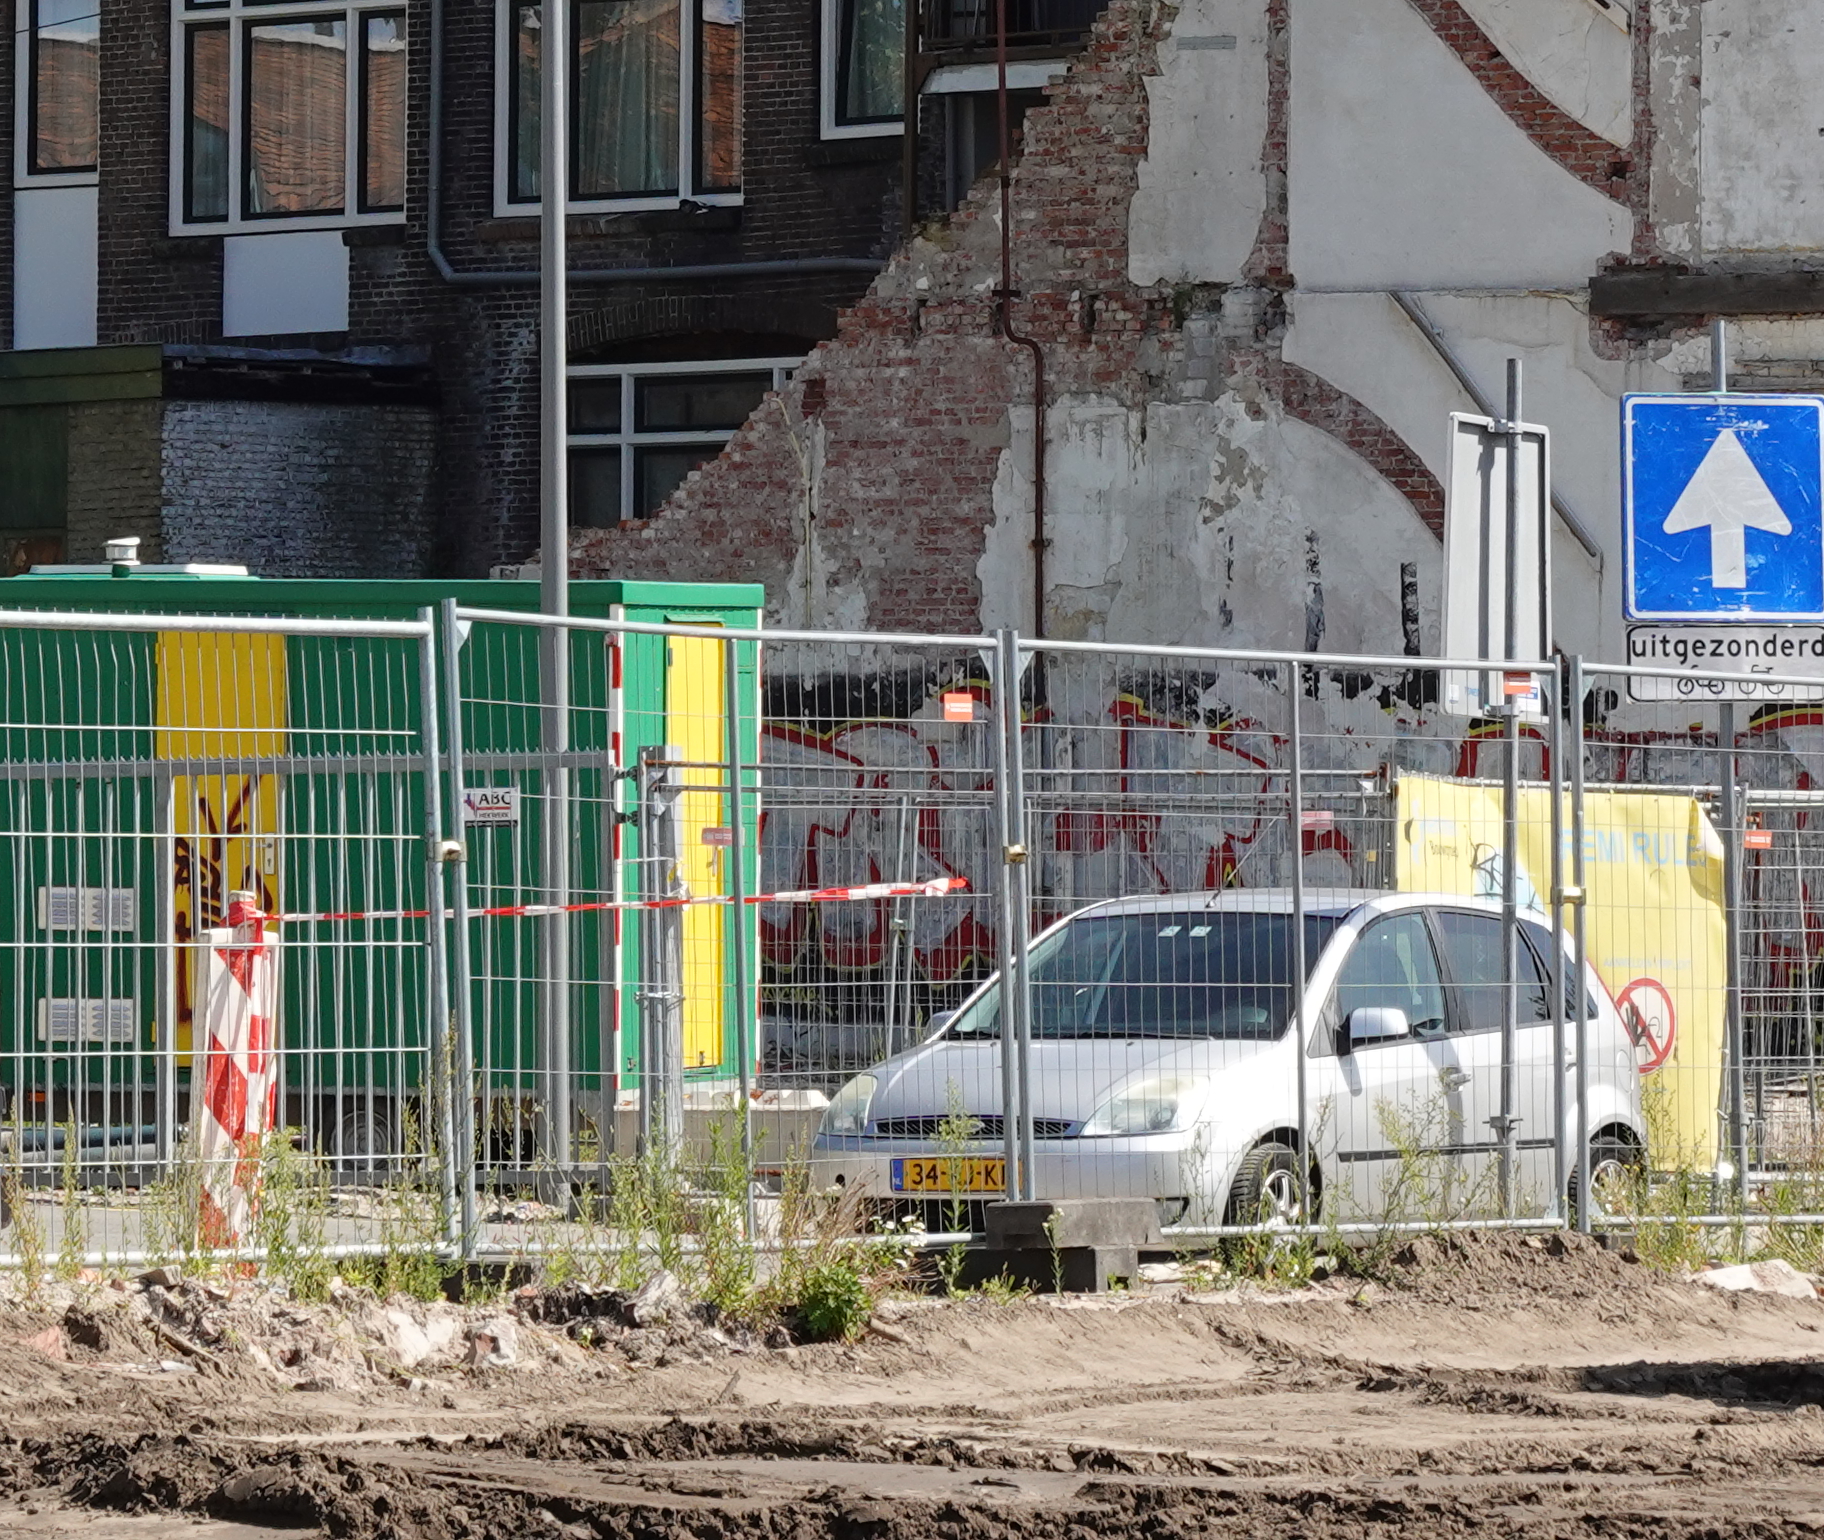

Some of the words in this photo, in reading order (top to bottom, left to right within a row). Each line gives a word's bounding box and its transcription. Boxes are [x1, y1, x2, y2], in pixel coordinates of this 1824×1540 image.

[1631, 633, 1824, 665] uitgezonderd
[479, 791, 511, 805] ABC
[1632, 832, 1708, 868] RULE
